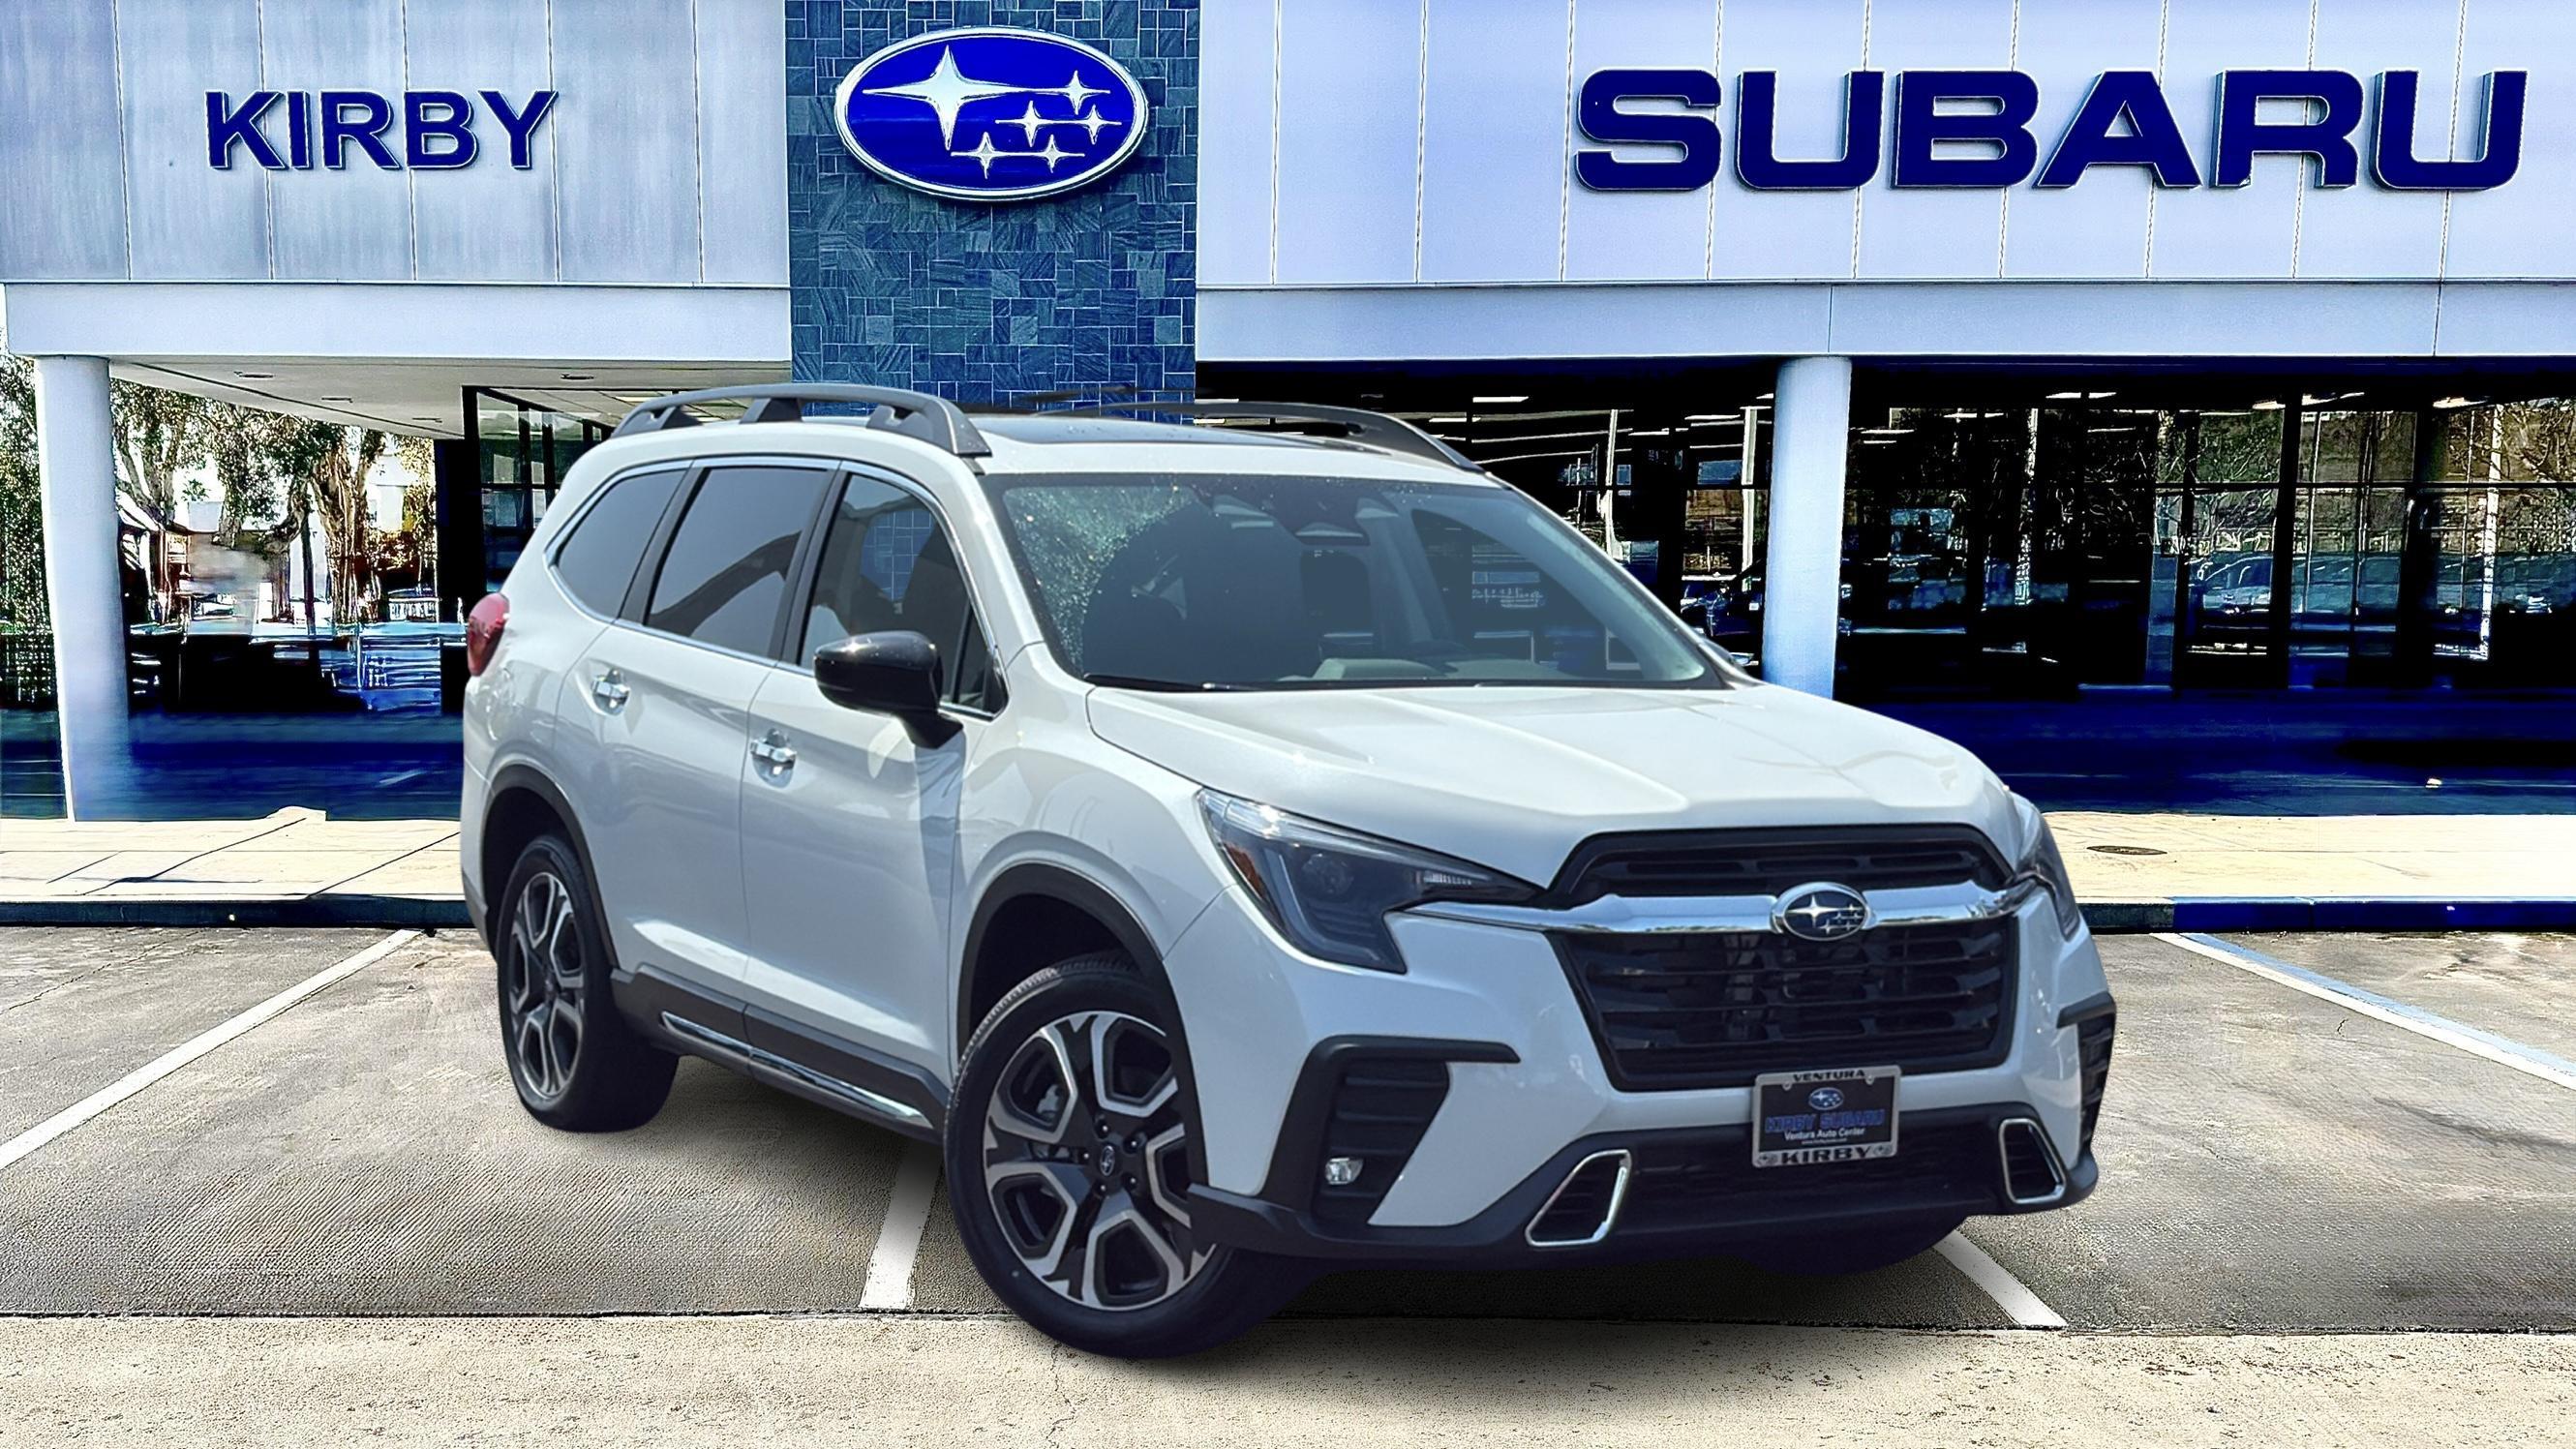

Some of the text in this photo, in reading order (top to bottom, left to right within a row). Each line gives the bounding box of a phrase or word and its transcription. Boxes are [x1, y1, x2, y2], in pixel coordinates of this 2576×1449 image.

[205, 91, 559, 169] KIRBY
[1576, 70, 2528, 192] SUBARU
[1793, 1070, 1865, 1081] VENTURA
[1765, 1109, 1885, 1132] KIRBY SUBARU
[1784, 1128, 1865, 1140] Ventura Auto Center
[1781, 1146, 1872, 1163] KIRBY
